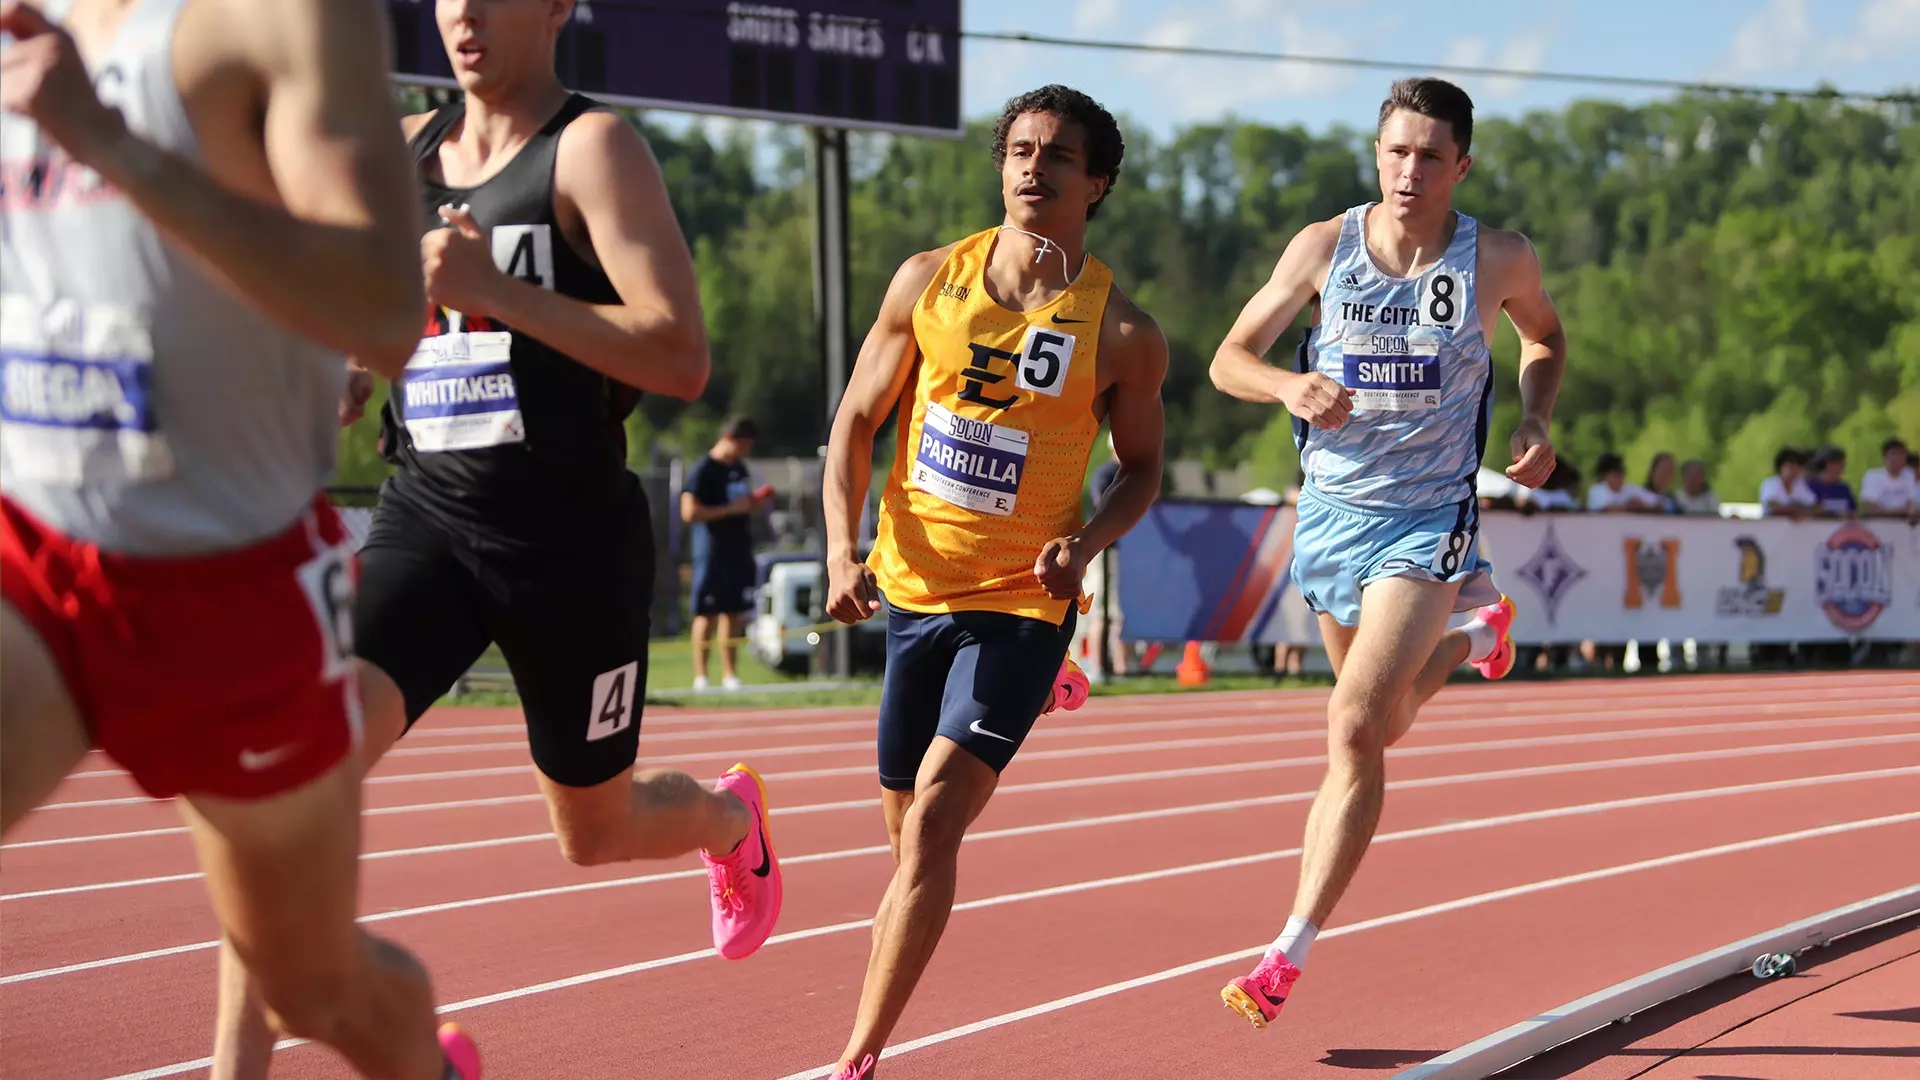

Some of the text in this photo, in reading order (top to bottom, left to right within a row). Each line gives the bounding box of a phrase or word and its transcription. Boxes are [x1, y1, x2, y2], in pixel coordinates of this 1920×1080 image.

[1336, 283, 1362, 291] adidas
[1430, 274, 1454, 322] 8
[1341, 302, 1375, 323] THE
[1024, 331, 1065, 388] 5
[1371, 335, 1409, 354] SOCON
[1358, 361, 1424, 383] SMITH
[406, 373, 516, 408] WHITTAKER
[948, 414, 994, 446] SOCON
[920, 432, 1017, 485] PARRILLA
[955, 483, 991, 499] CONFERENCE
[1441, 530, 1465, 574] 8
[598, 671, 627, 729] 4
